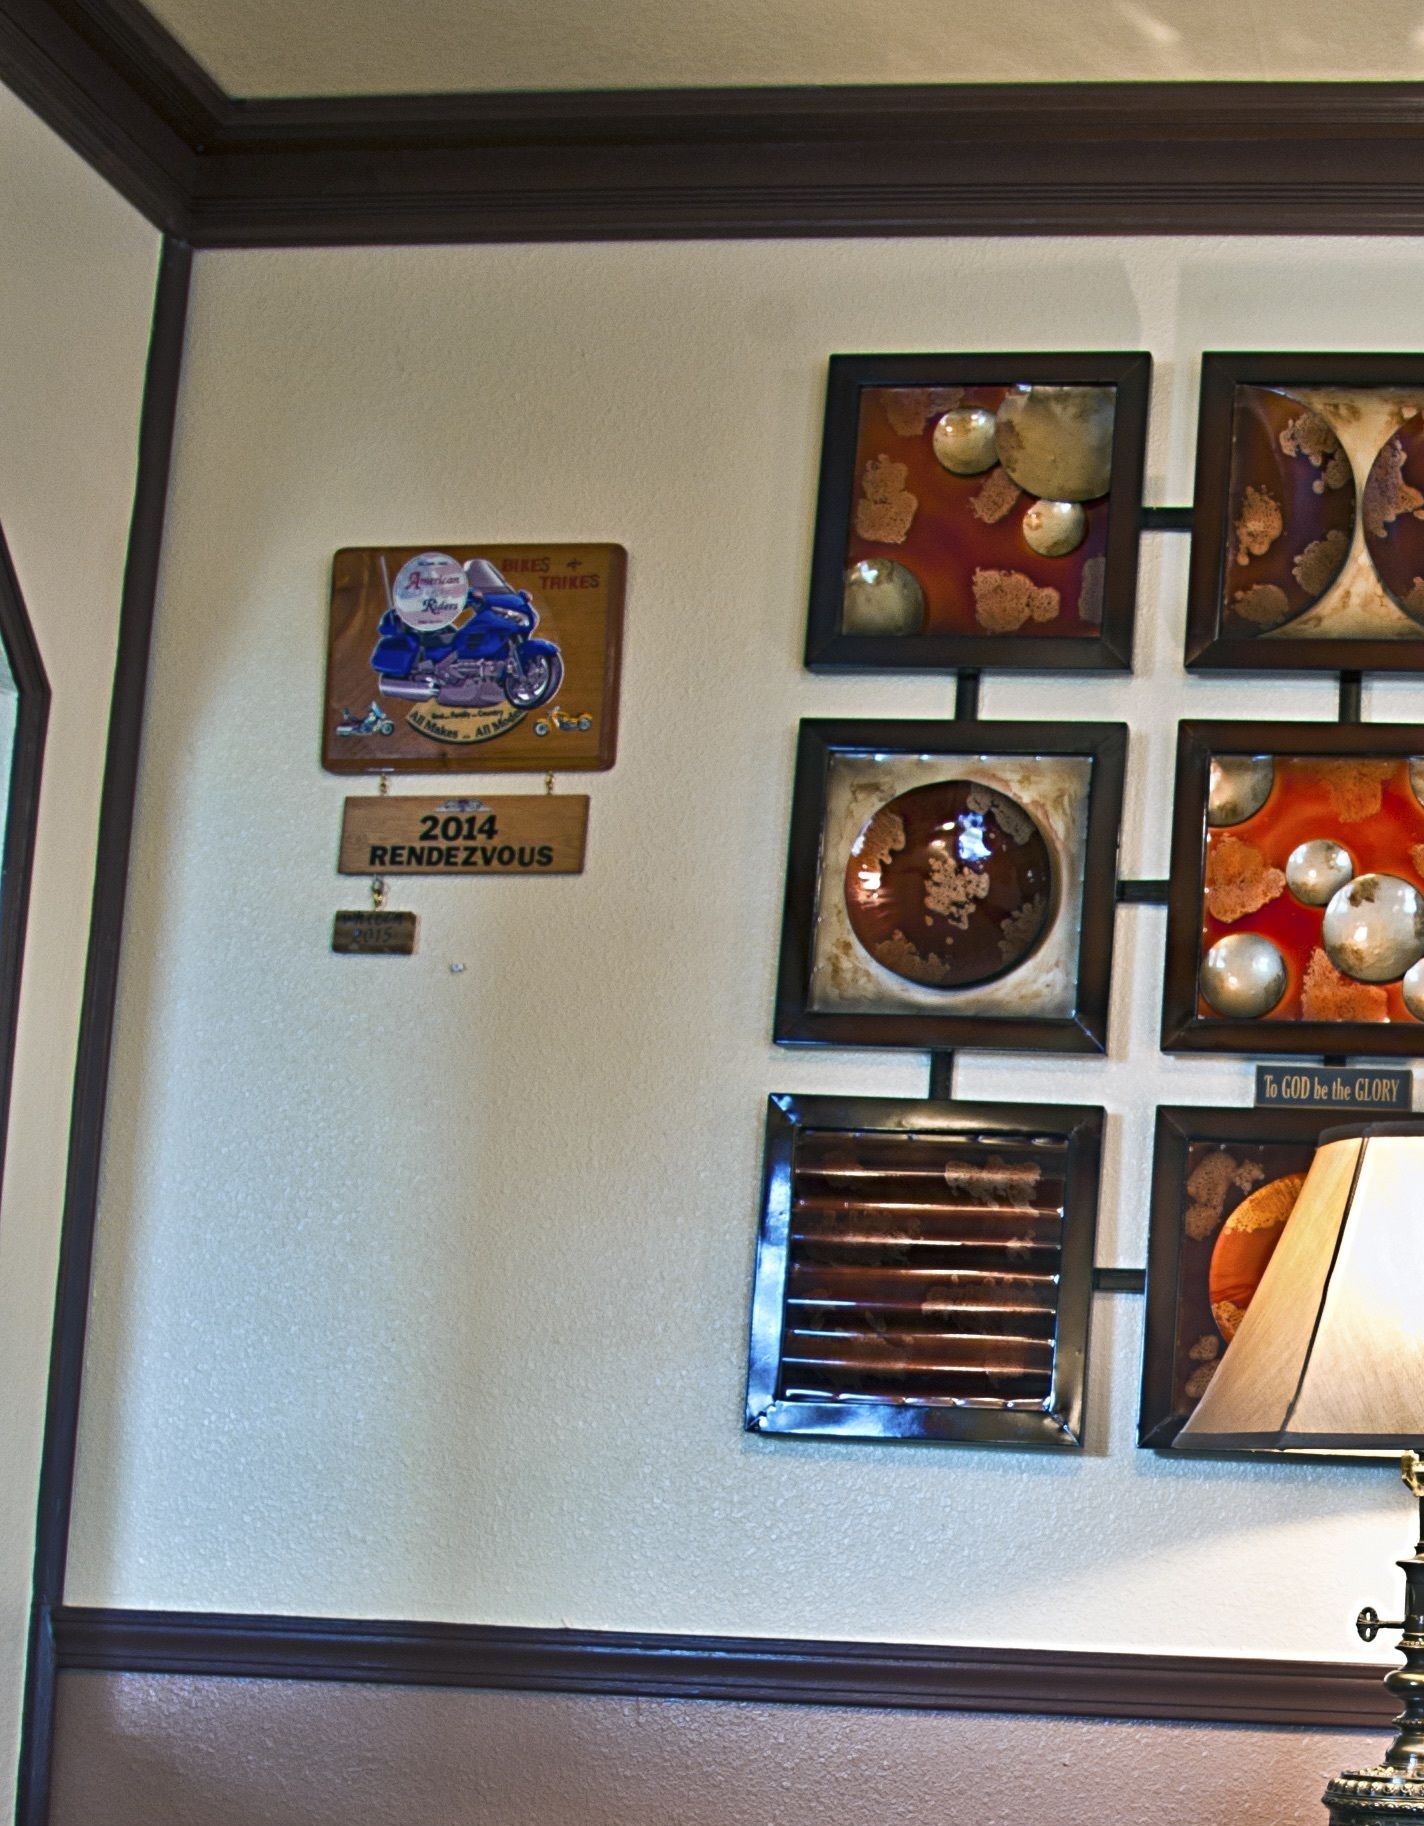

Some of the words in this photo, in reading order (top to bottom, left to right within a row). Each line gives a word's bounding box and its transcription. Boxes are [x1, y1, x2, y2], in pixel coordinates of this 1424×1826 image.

[502, 557, 550, 572] BIKES
[540, 575, 600, 590] TRIKES
[418, 814, 499, 841] 2014
[368, 845, 554, 868] RENDEZVOUS
[1264, 1074, 1278, 1098] To
[1281, 1074, 1311, 1099] GOD
[1314, 1076, 1328, 1100] be
[1331, 1077, 1351, 1101] the
[1355, 1078, 1400, 1102] GLORY
